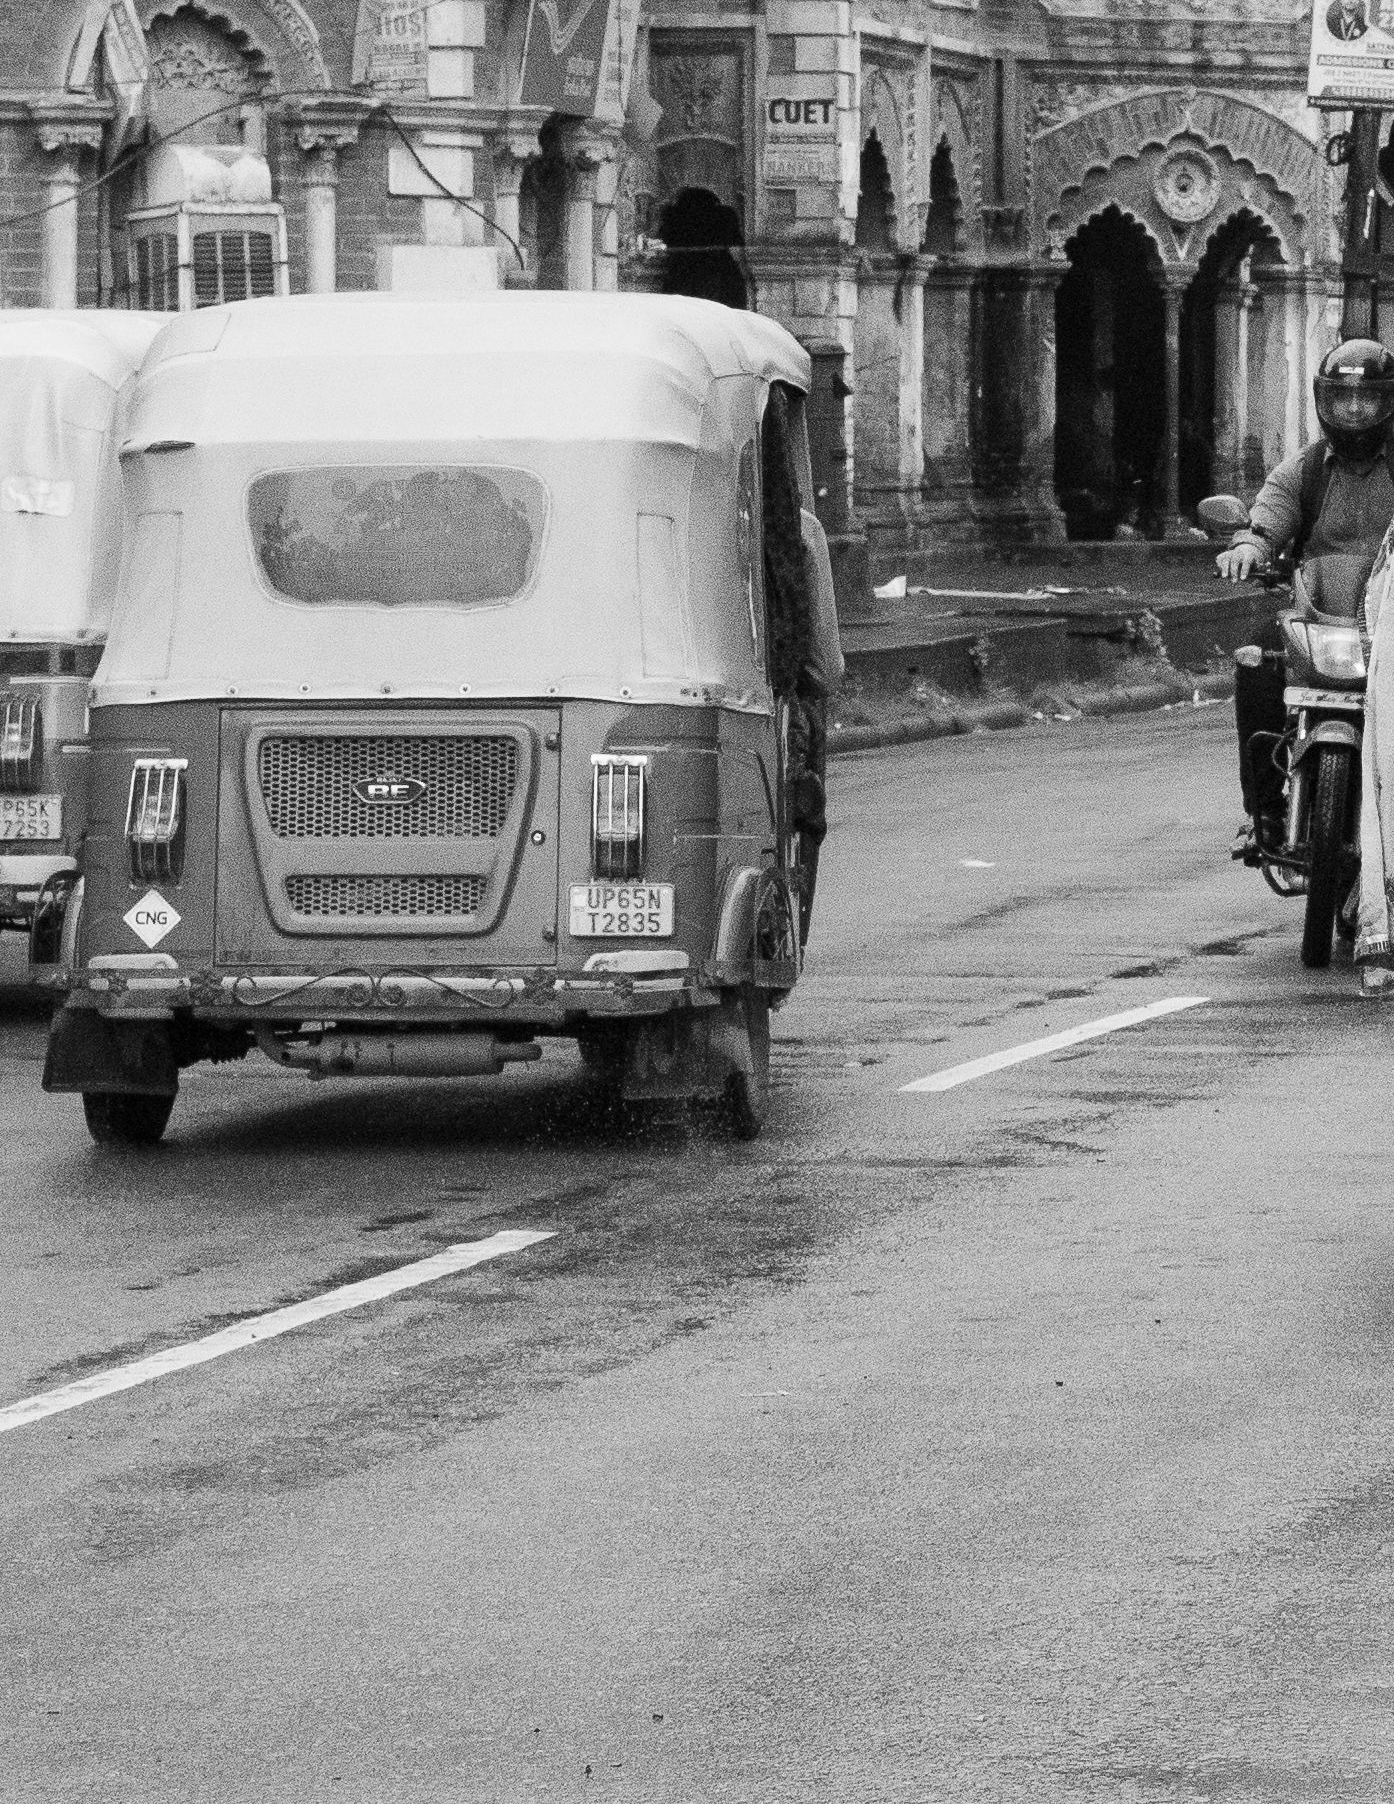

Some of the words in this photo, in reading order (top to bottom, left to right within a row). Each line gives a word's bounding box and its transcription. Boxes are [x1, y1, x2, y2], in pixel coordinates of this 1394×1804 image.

[769, 98, 835, 125] CUET
[3, 819, 50, 837] 7253
[587, 888, 660, 909] UP65N
[135, 911, 168, 925] CNG
[587, 912, 660, 934] T2835
